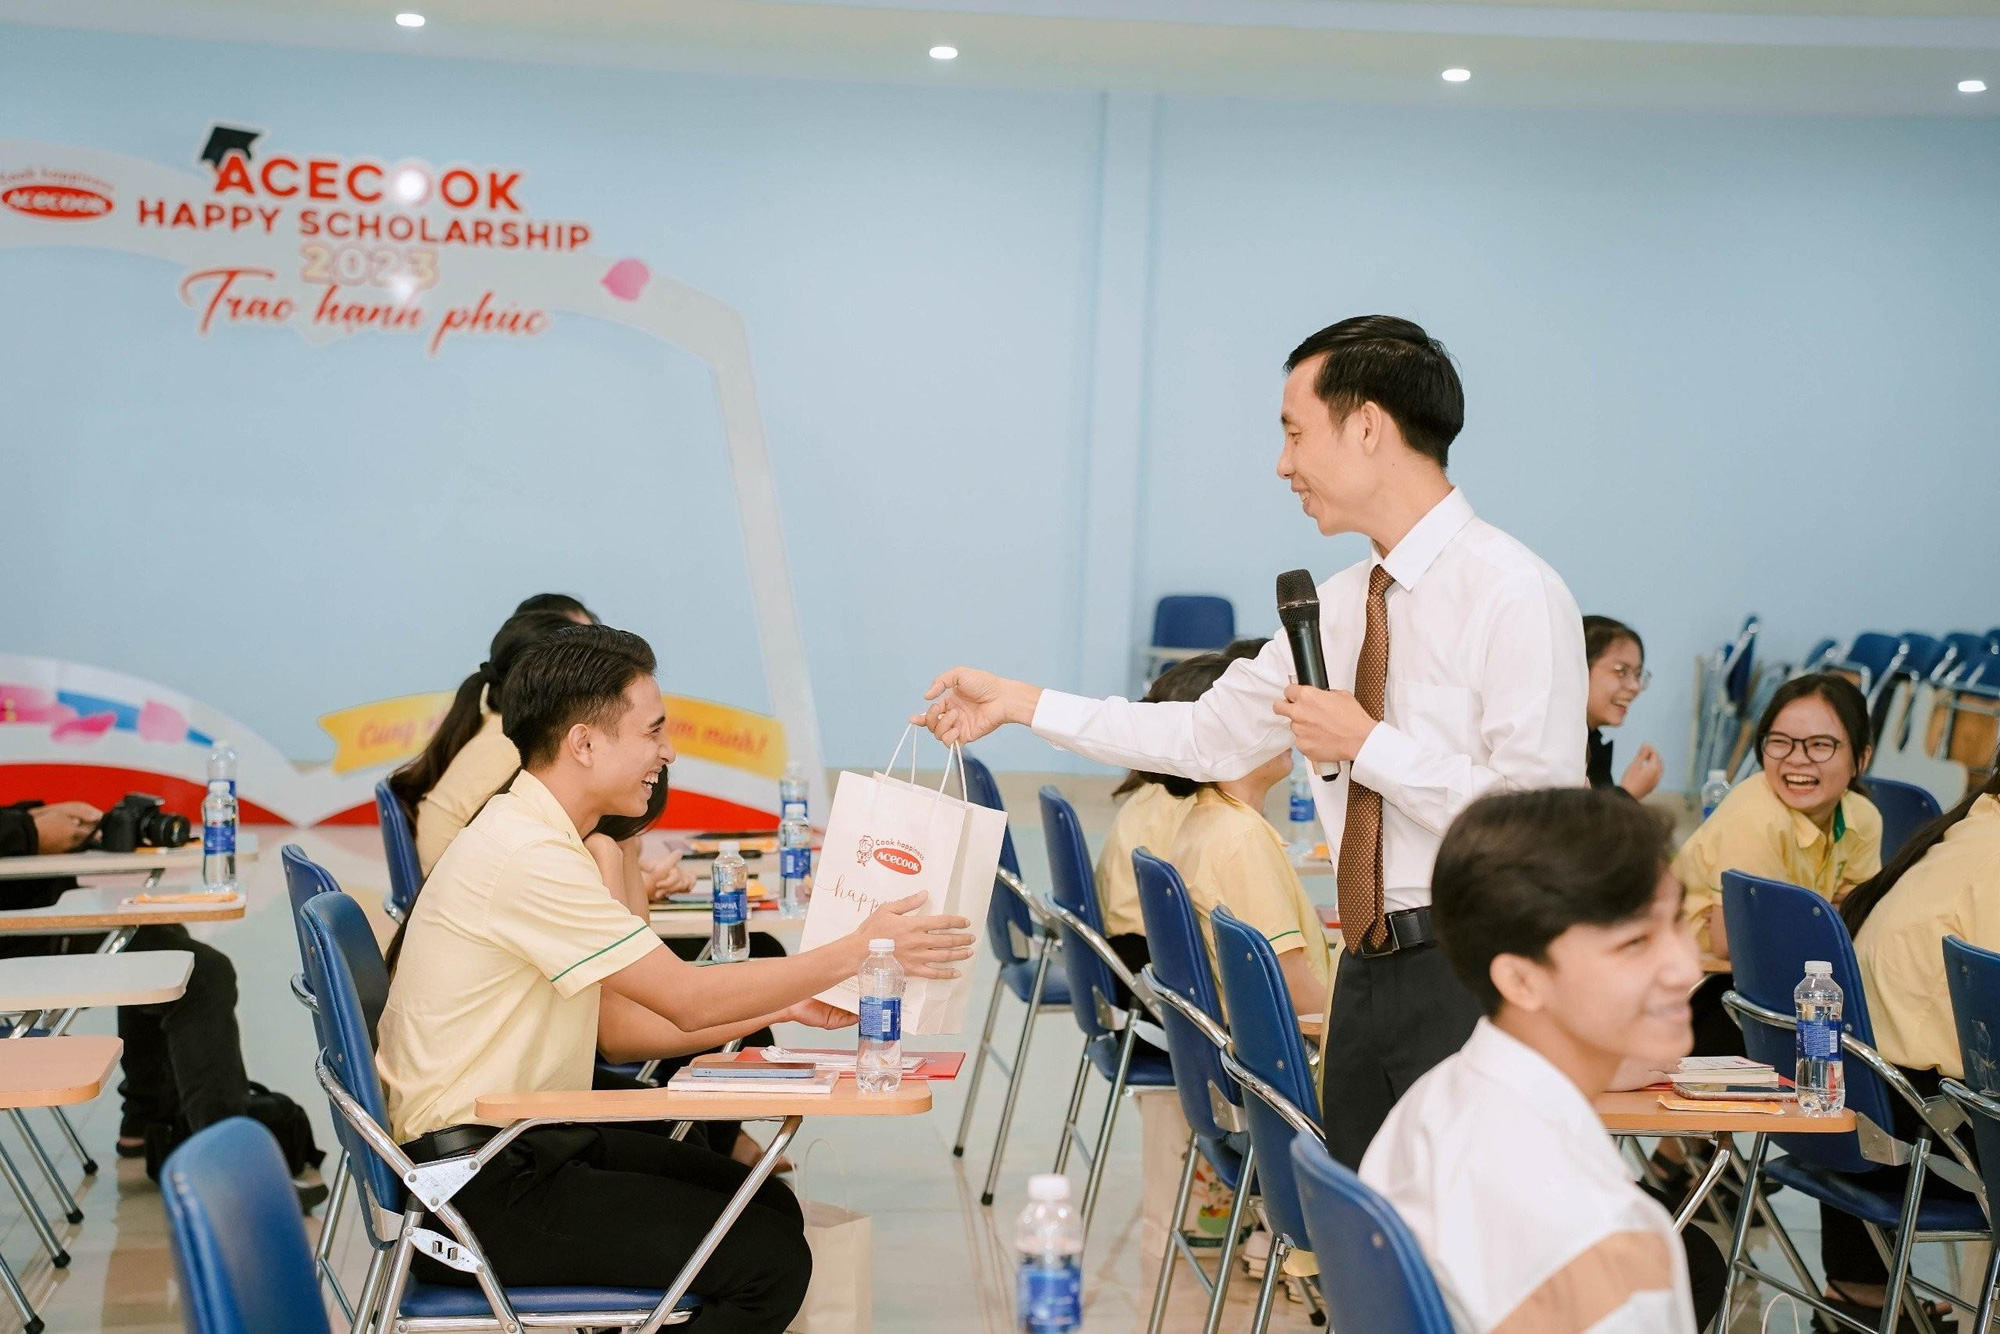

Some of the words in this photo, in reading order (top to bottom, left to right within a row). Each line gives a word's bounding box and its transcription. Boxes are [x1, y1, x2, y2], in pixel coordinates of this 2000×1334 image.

[138, 198, 281, 234] HAPPY
[300, 210, 591, 249] SCHOLARSHIP
[301, 243, 440, 287] 2023
[179, 266, 297, 335] Trao
[875, 838, 895, 846] Cook
[815, 873, 890, 914] happ
